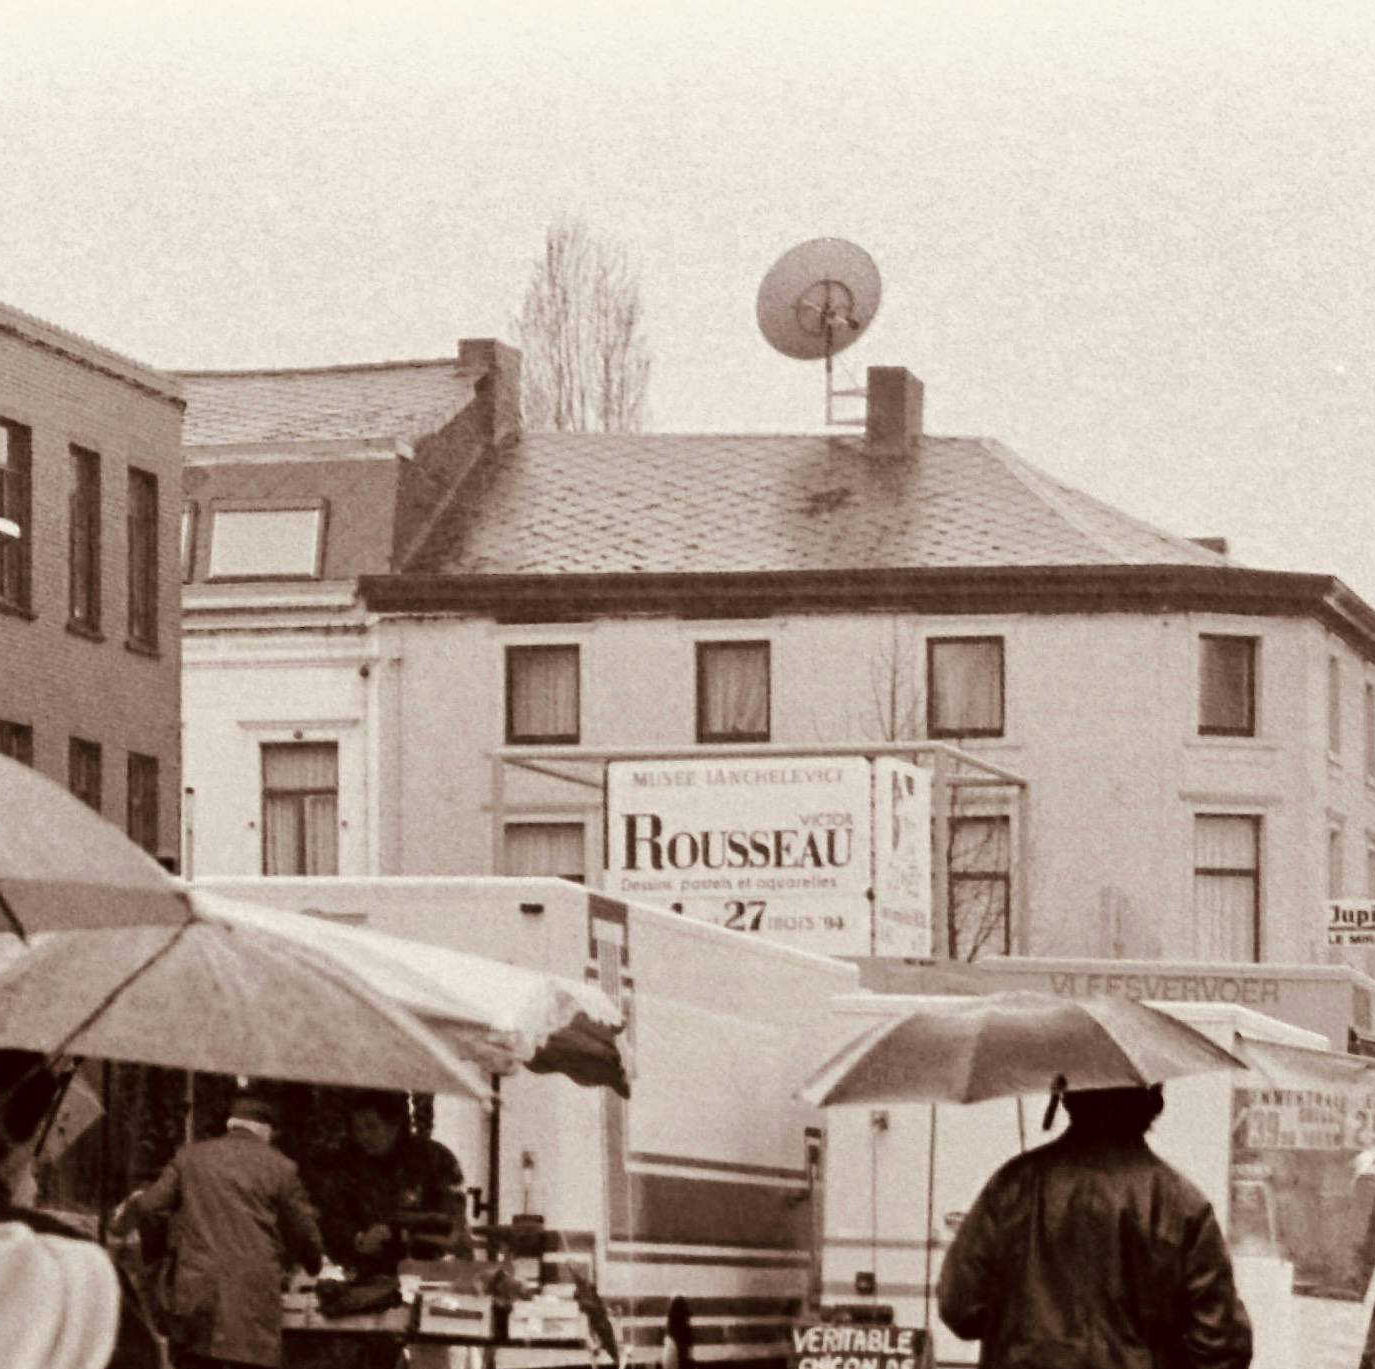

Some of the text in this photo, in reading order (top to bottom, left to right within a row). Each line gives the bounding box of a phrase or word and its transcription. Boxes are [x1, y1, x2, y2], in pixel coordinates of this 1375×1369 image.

[800, 812, 854, 827] VICTOR
[621, 812, 855, 871] ROUSSEAU
[724, 900, 768, 931] 27
[792, 1326, 915, 1355] VERITABLE
